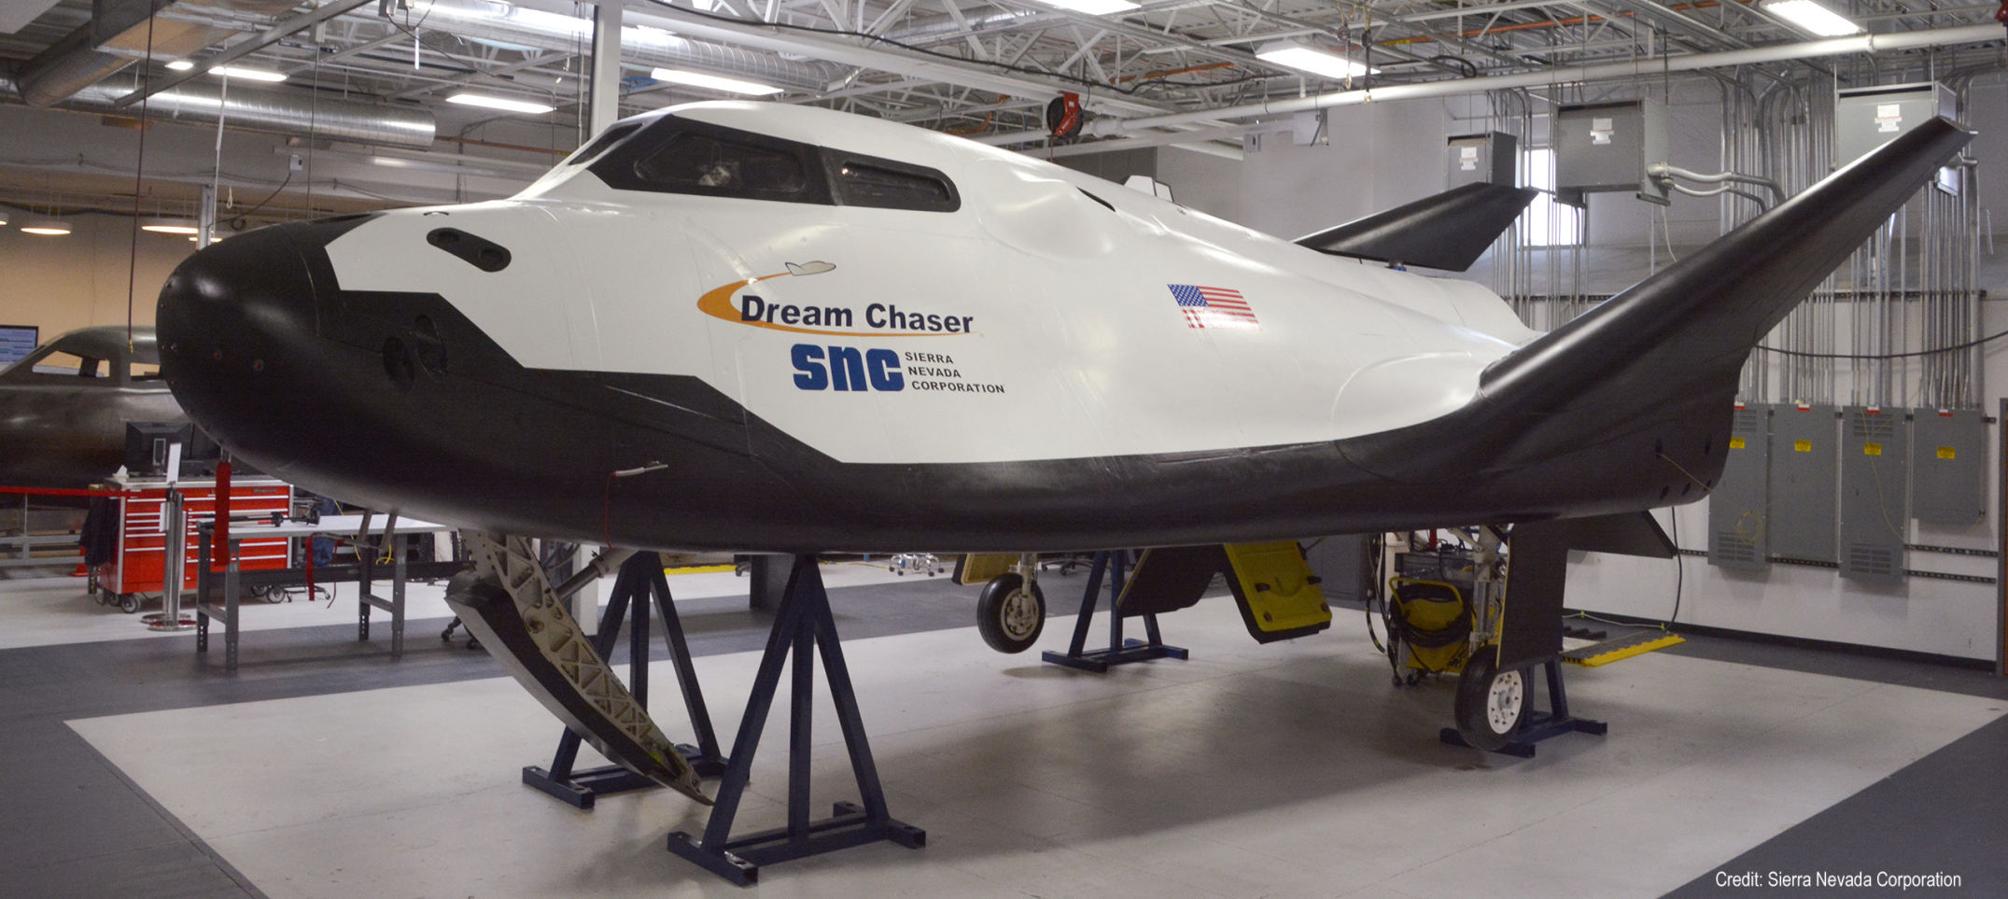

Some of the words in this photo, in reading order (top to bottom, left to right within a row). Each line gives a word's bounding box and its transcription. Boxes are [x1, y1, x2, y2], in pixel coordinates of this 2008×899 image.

[741, 295, 853, 327] Dream
[865, 303, 974, 333] Chaser
[905, 351, 954, 364] SIERRA
[908, 366, 962, 379] NEVADA
[911, 380, 1006, 394] CORPORATION
